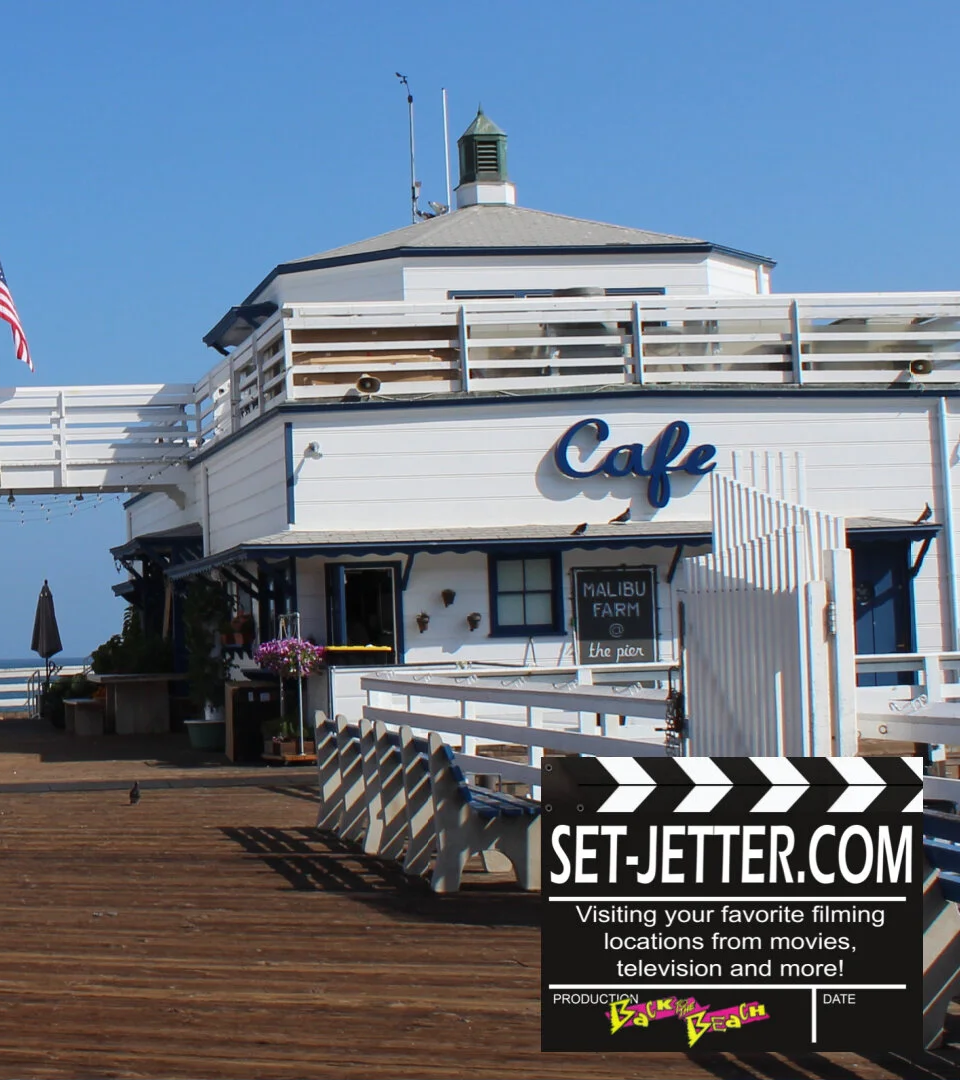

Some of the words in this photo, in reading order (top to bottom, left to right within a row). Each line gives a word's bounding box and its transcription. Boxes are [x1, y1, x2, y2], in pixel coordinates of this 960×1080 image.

[556, 418, 717, 509] Cafe
[583, 581, 646, 598] MALIBU
[592, 602, 640, 618] FARM
[609, 623, 624, 638] @
[588, 642, 611, 659] the
[615, 644, 645, 664] pier
